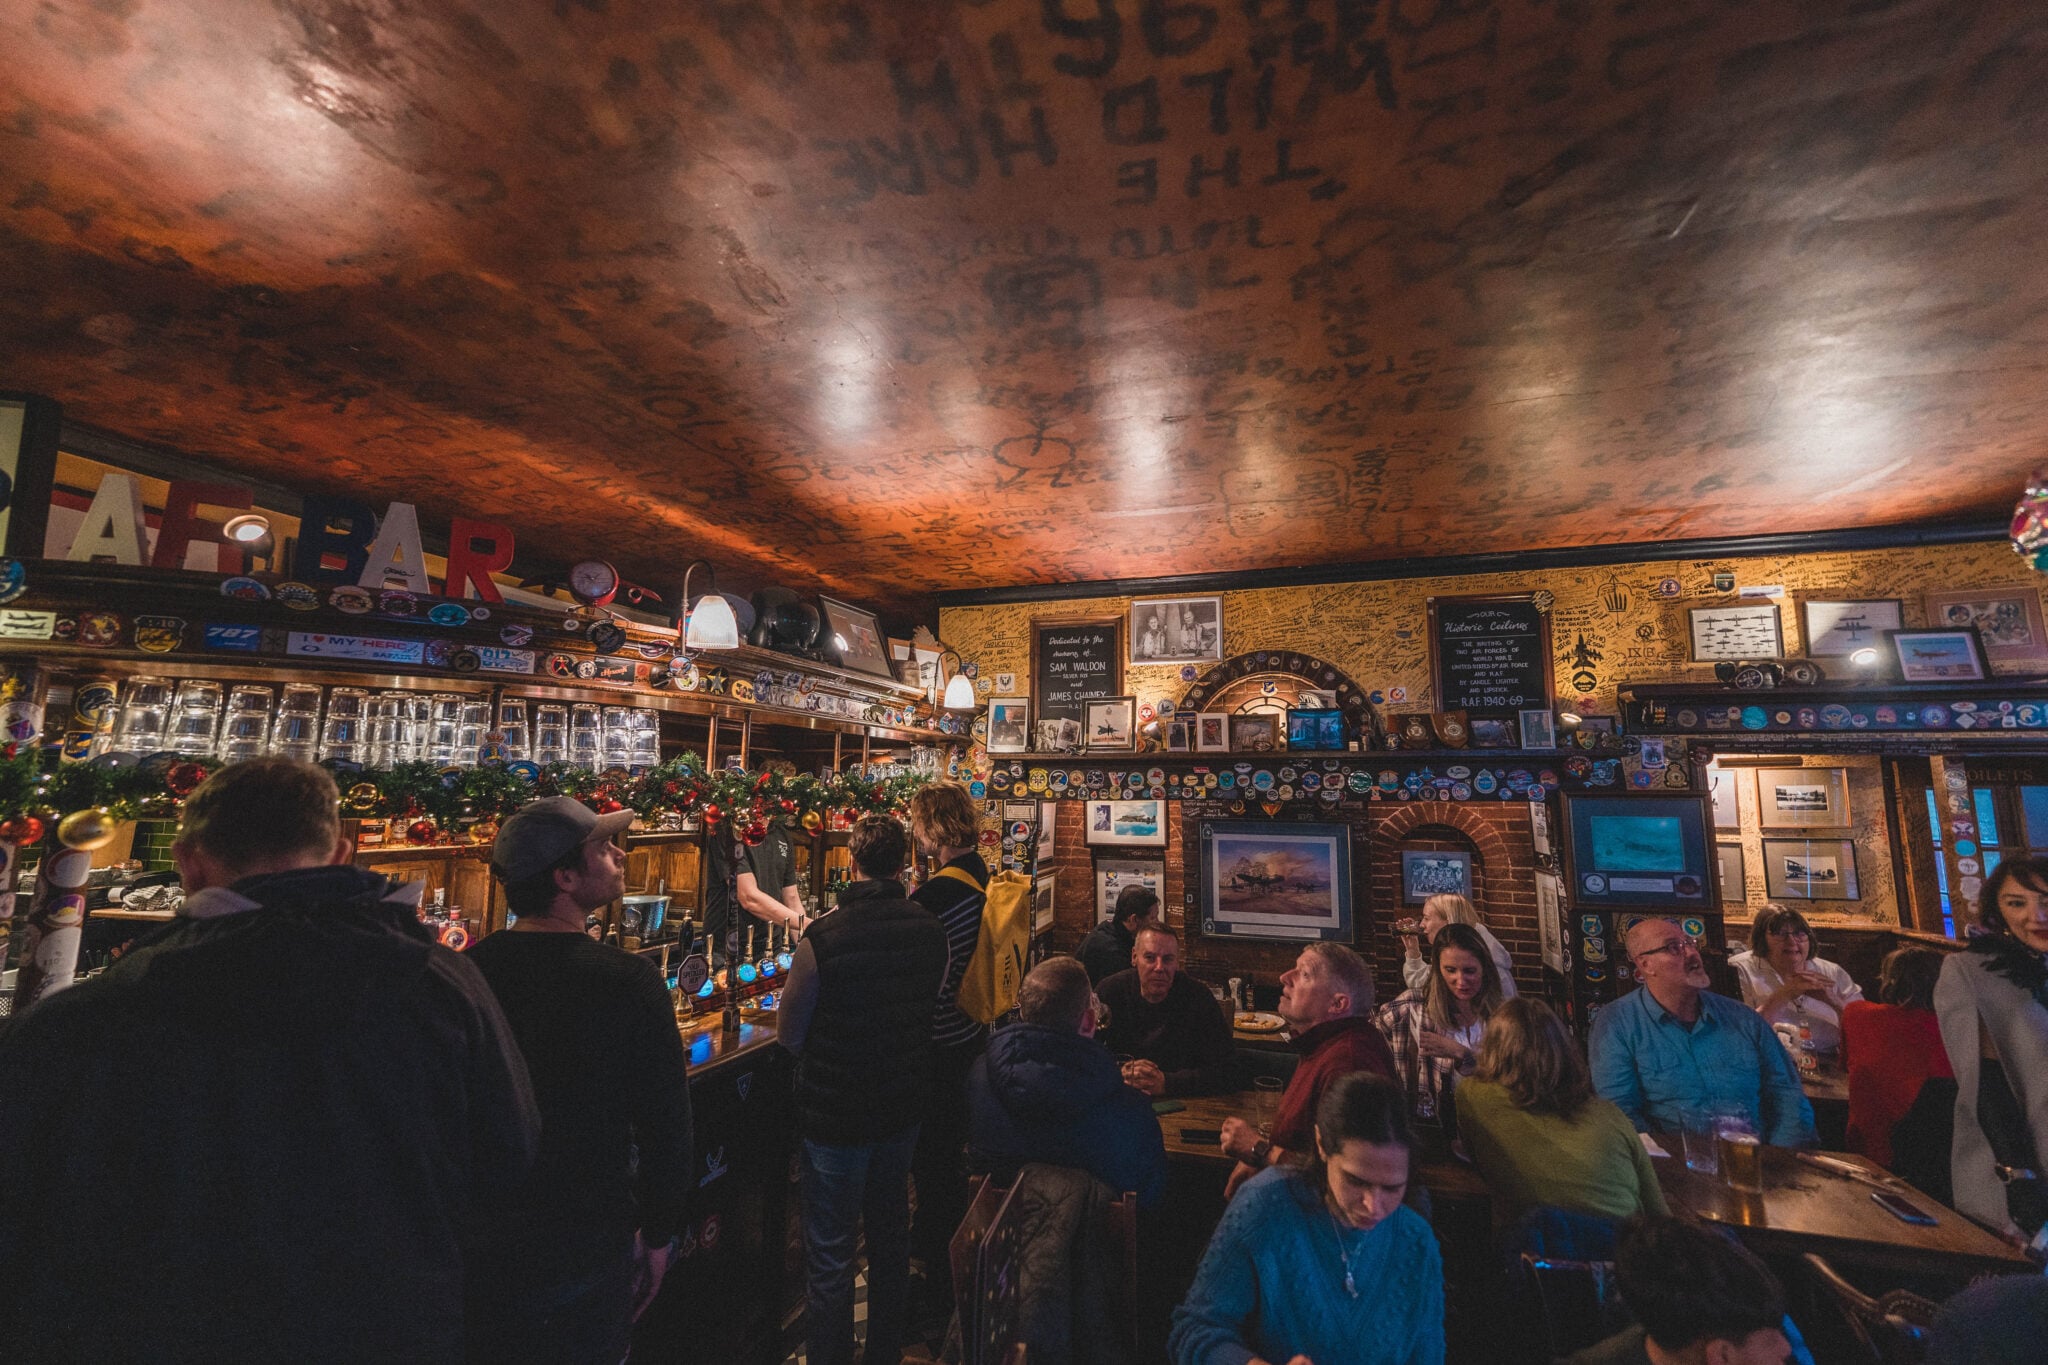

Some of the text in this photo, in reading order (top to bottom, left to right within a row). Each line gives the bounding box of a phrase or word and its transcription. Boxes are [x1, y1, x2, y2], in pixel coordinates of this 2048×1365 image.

[295, 494, 515, 604] BAR
[1444, 622, 1484, 633] Historic
[206, 627, 258, 639] 787
[328, 637, 356, 646] MY
[1048, 635, 1104, 645] Dedicated to the
[1049, 661, 1106, 672] SAM WALDON
[1070, 680, 1084, 688] and
[1048, 691, 1072, 701] JAMES
[1483, 696, 1524, 706] 1940-69
[1966, 768, 2033, 781] OILETS
